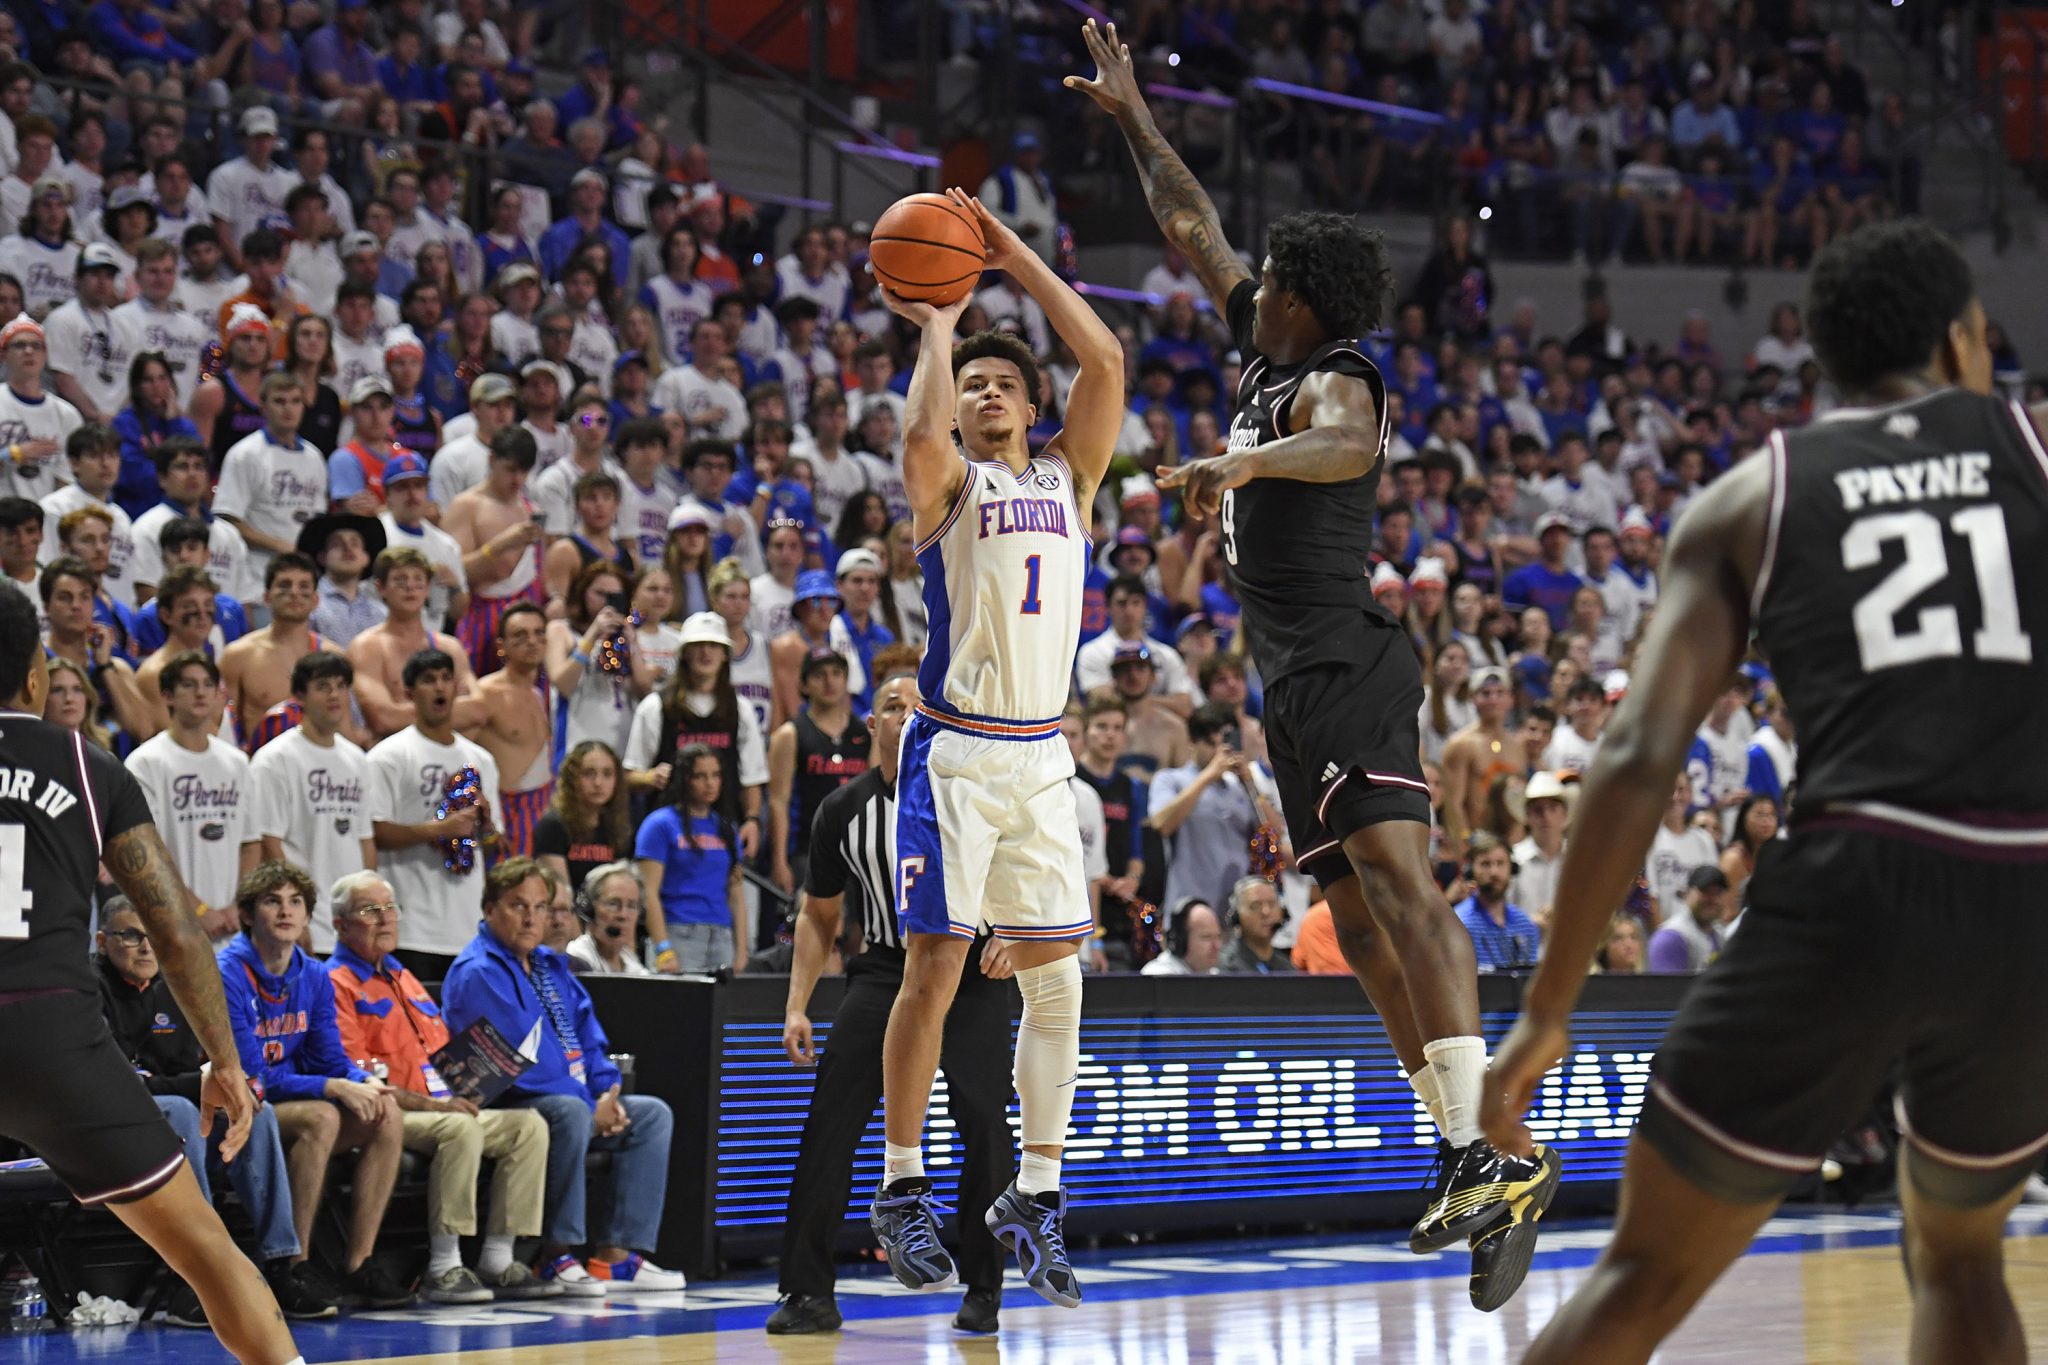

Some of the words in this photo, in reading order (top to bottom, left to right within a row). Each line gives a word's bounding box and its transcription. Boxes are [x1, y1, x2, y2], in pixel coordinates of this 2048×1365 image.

[1834, 452, 1991, 511] PAYNE
[978, 498, 1068, 540] FLORIDA
[1222, 488, 1238, 566] 9
[1020, 554, 1041, 615] 1
[1840, 503, 2033, 673] 21
[35, 779, 78, 819] IV
[900, 857, 927, 911] F
[1213, 1050, 1381, 1152] ORL
